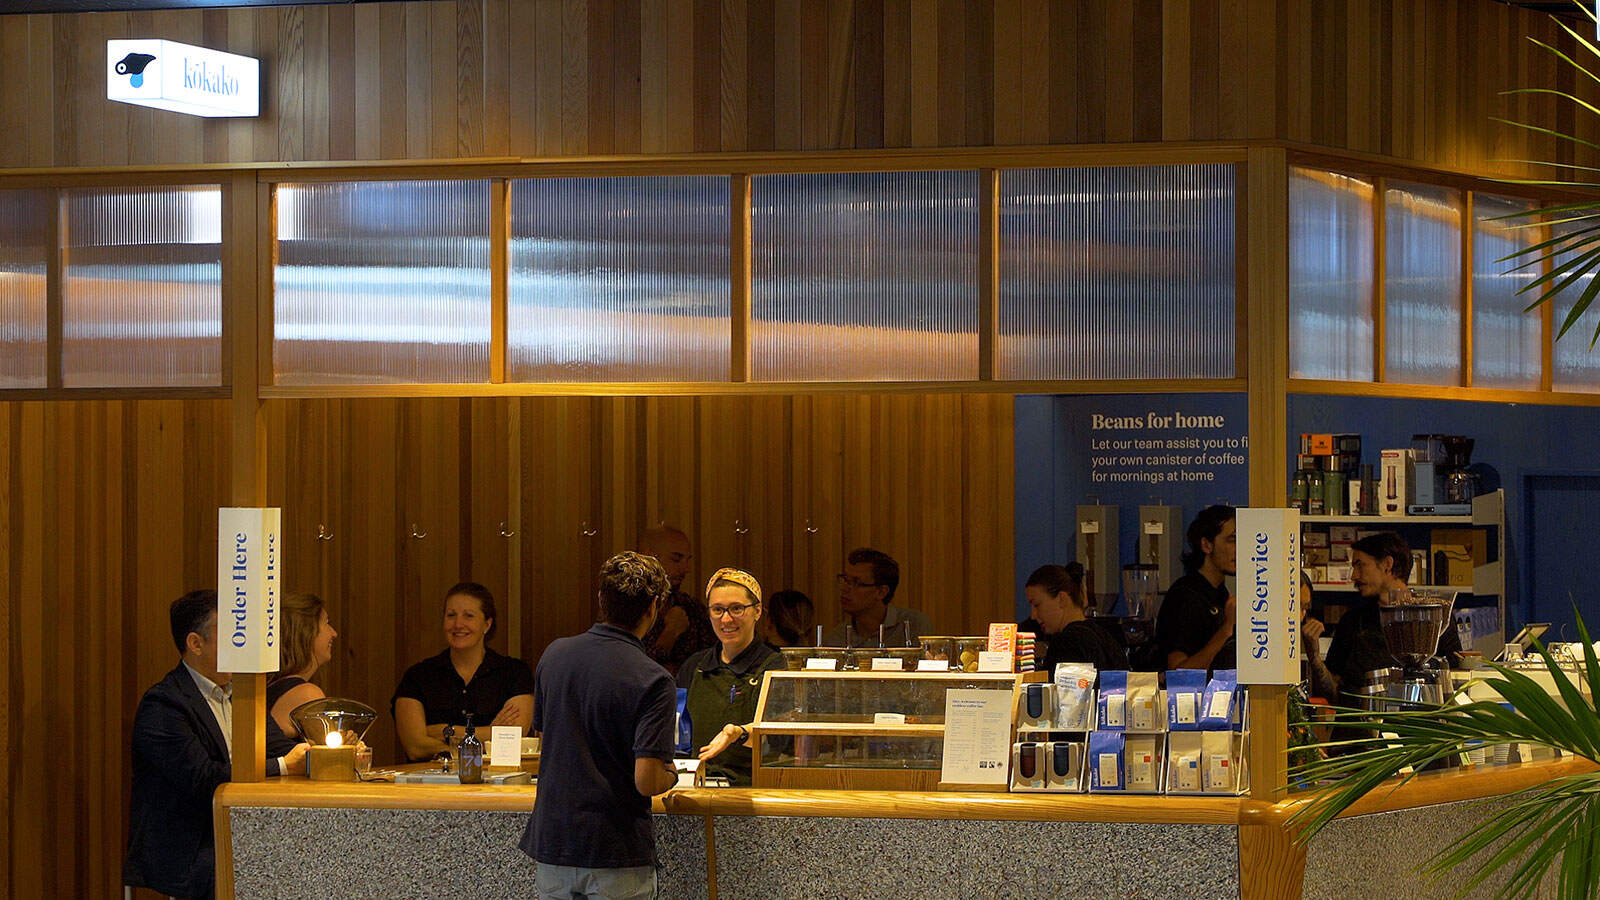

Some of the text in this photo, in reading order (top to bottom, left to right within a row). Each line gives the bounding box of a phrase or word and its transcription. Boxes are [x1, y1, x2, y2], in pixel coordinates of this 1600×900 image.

[184, 57, 239, 96] kōkako
[1091, 412, 1225, 429] Beans for home
[1092, 438, 1110, 450] Let
[1112, 440, 1132, 450] our
[1134, 438, 1164, 450] team
[1166, 437, 1201, 449] assist
[1203, 438, 1224, 452] you
[1226, 437, 1239, 448] to
[1092, 452, 1245, 468] your own canister of coffee
[1092, 469, 1215, 484] for mornings at home
[231, 532, 248, 648] Order Here
[266, 532, 275, 647] Order Here
[1251, 532, 1269, 660] Self Service
[1287, 532, 1296, 659] Self Service
